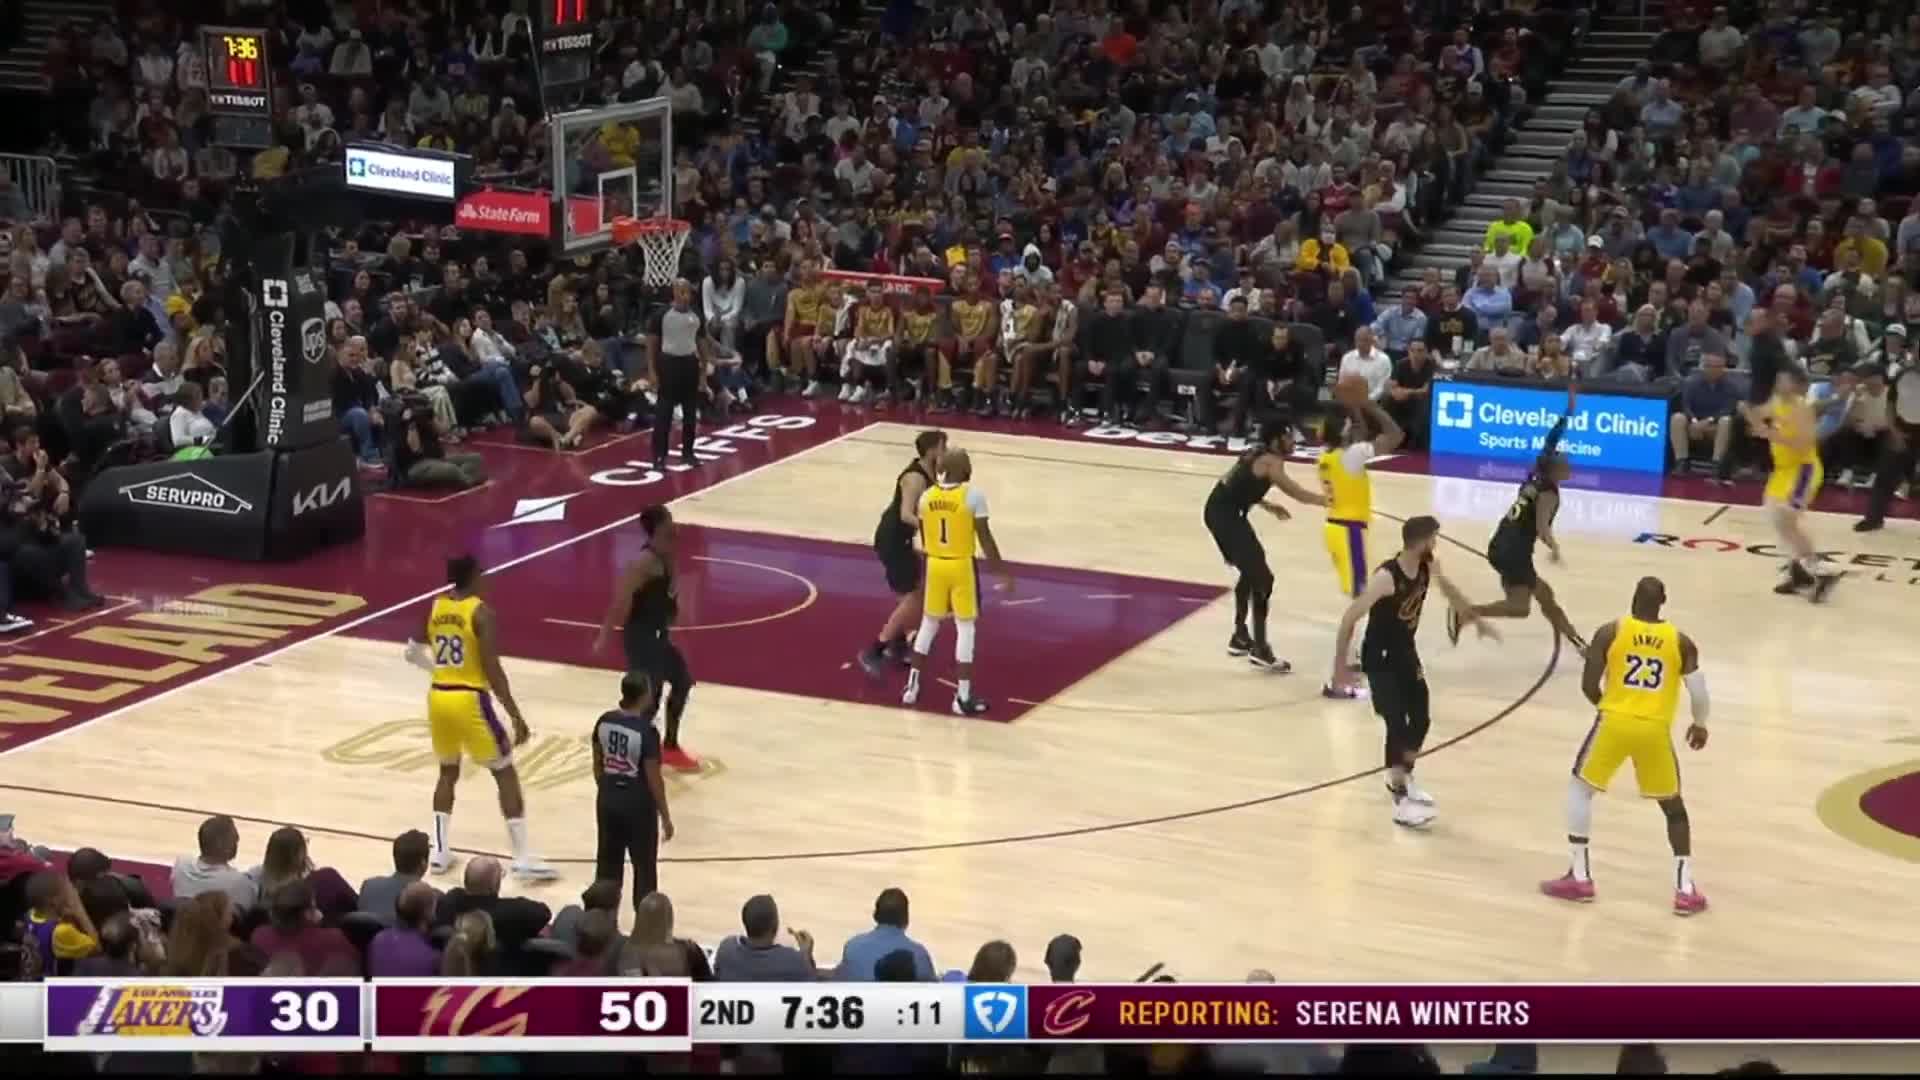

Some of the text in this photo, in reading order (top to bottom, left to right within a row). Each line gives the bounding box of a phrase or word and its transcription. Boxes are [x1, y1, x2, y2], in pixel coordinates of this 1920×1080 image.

[223, 36, 258, 58] 7:36
[557, 33, 593, 49] TISSOT
[230, 60, 254, 84] 11
[224, 95, 265, 106] TISSOT
[368, 163, 451, 184] Cleveland Clinic
[267, 311, 286, 445] Cleveland Clinic
[1479, 403, 1660, 437] Cleveland Clinic
[1479, 432, 1601, 457] Sports Mdicine
[146, 486, 225, 508] SERVPRO
[436, 634, 463, 665] 28
[1624, 654, 1663, 689] 23
